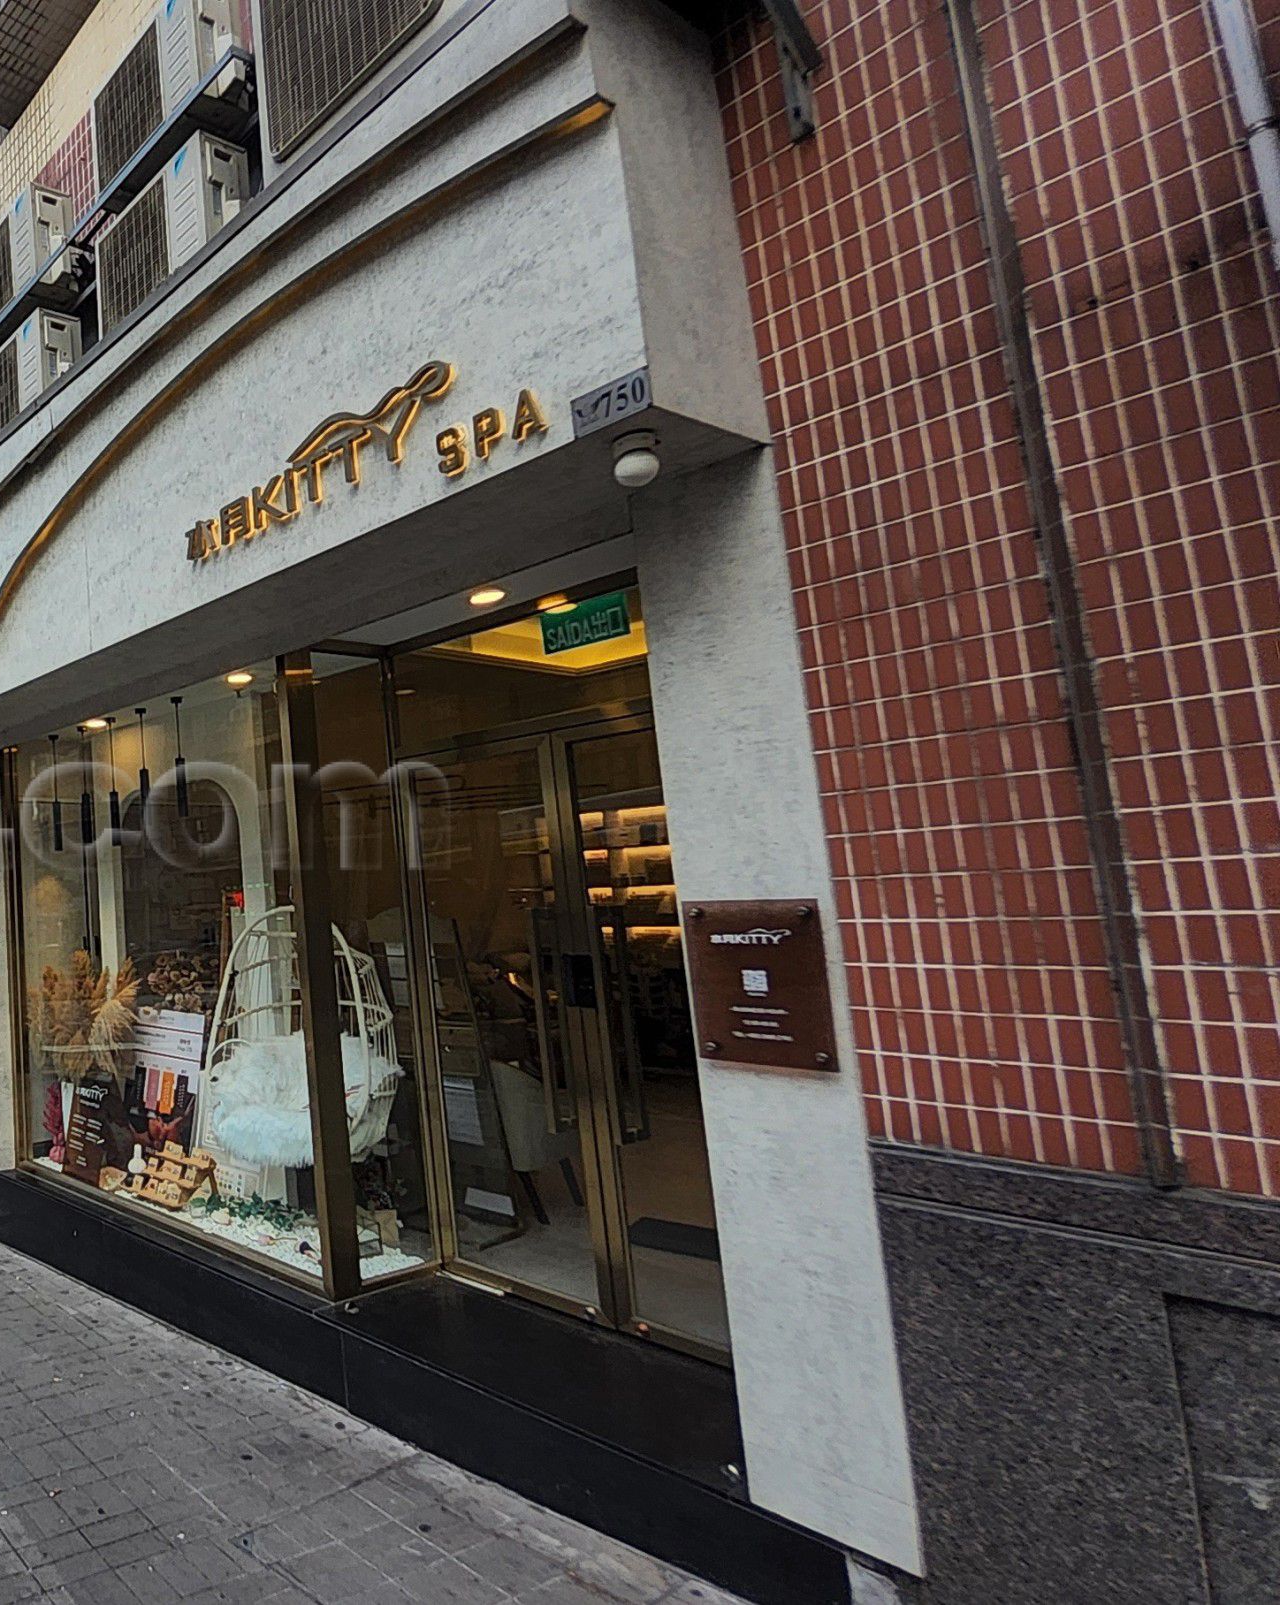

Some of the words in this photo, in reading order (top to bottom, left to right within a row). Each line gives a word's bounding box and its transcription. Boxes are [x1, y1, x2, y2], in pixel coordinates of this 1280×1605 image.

[600, 376, 645, 418] 750
[252, 398, 422, 530] KITTY
[436, 388, 549, 478] SPA
[546, 617, 594, 650] SAÍDA
[591, 605, 624, 637] 出口
